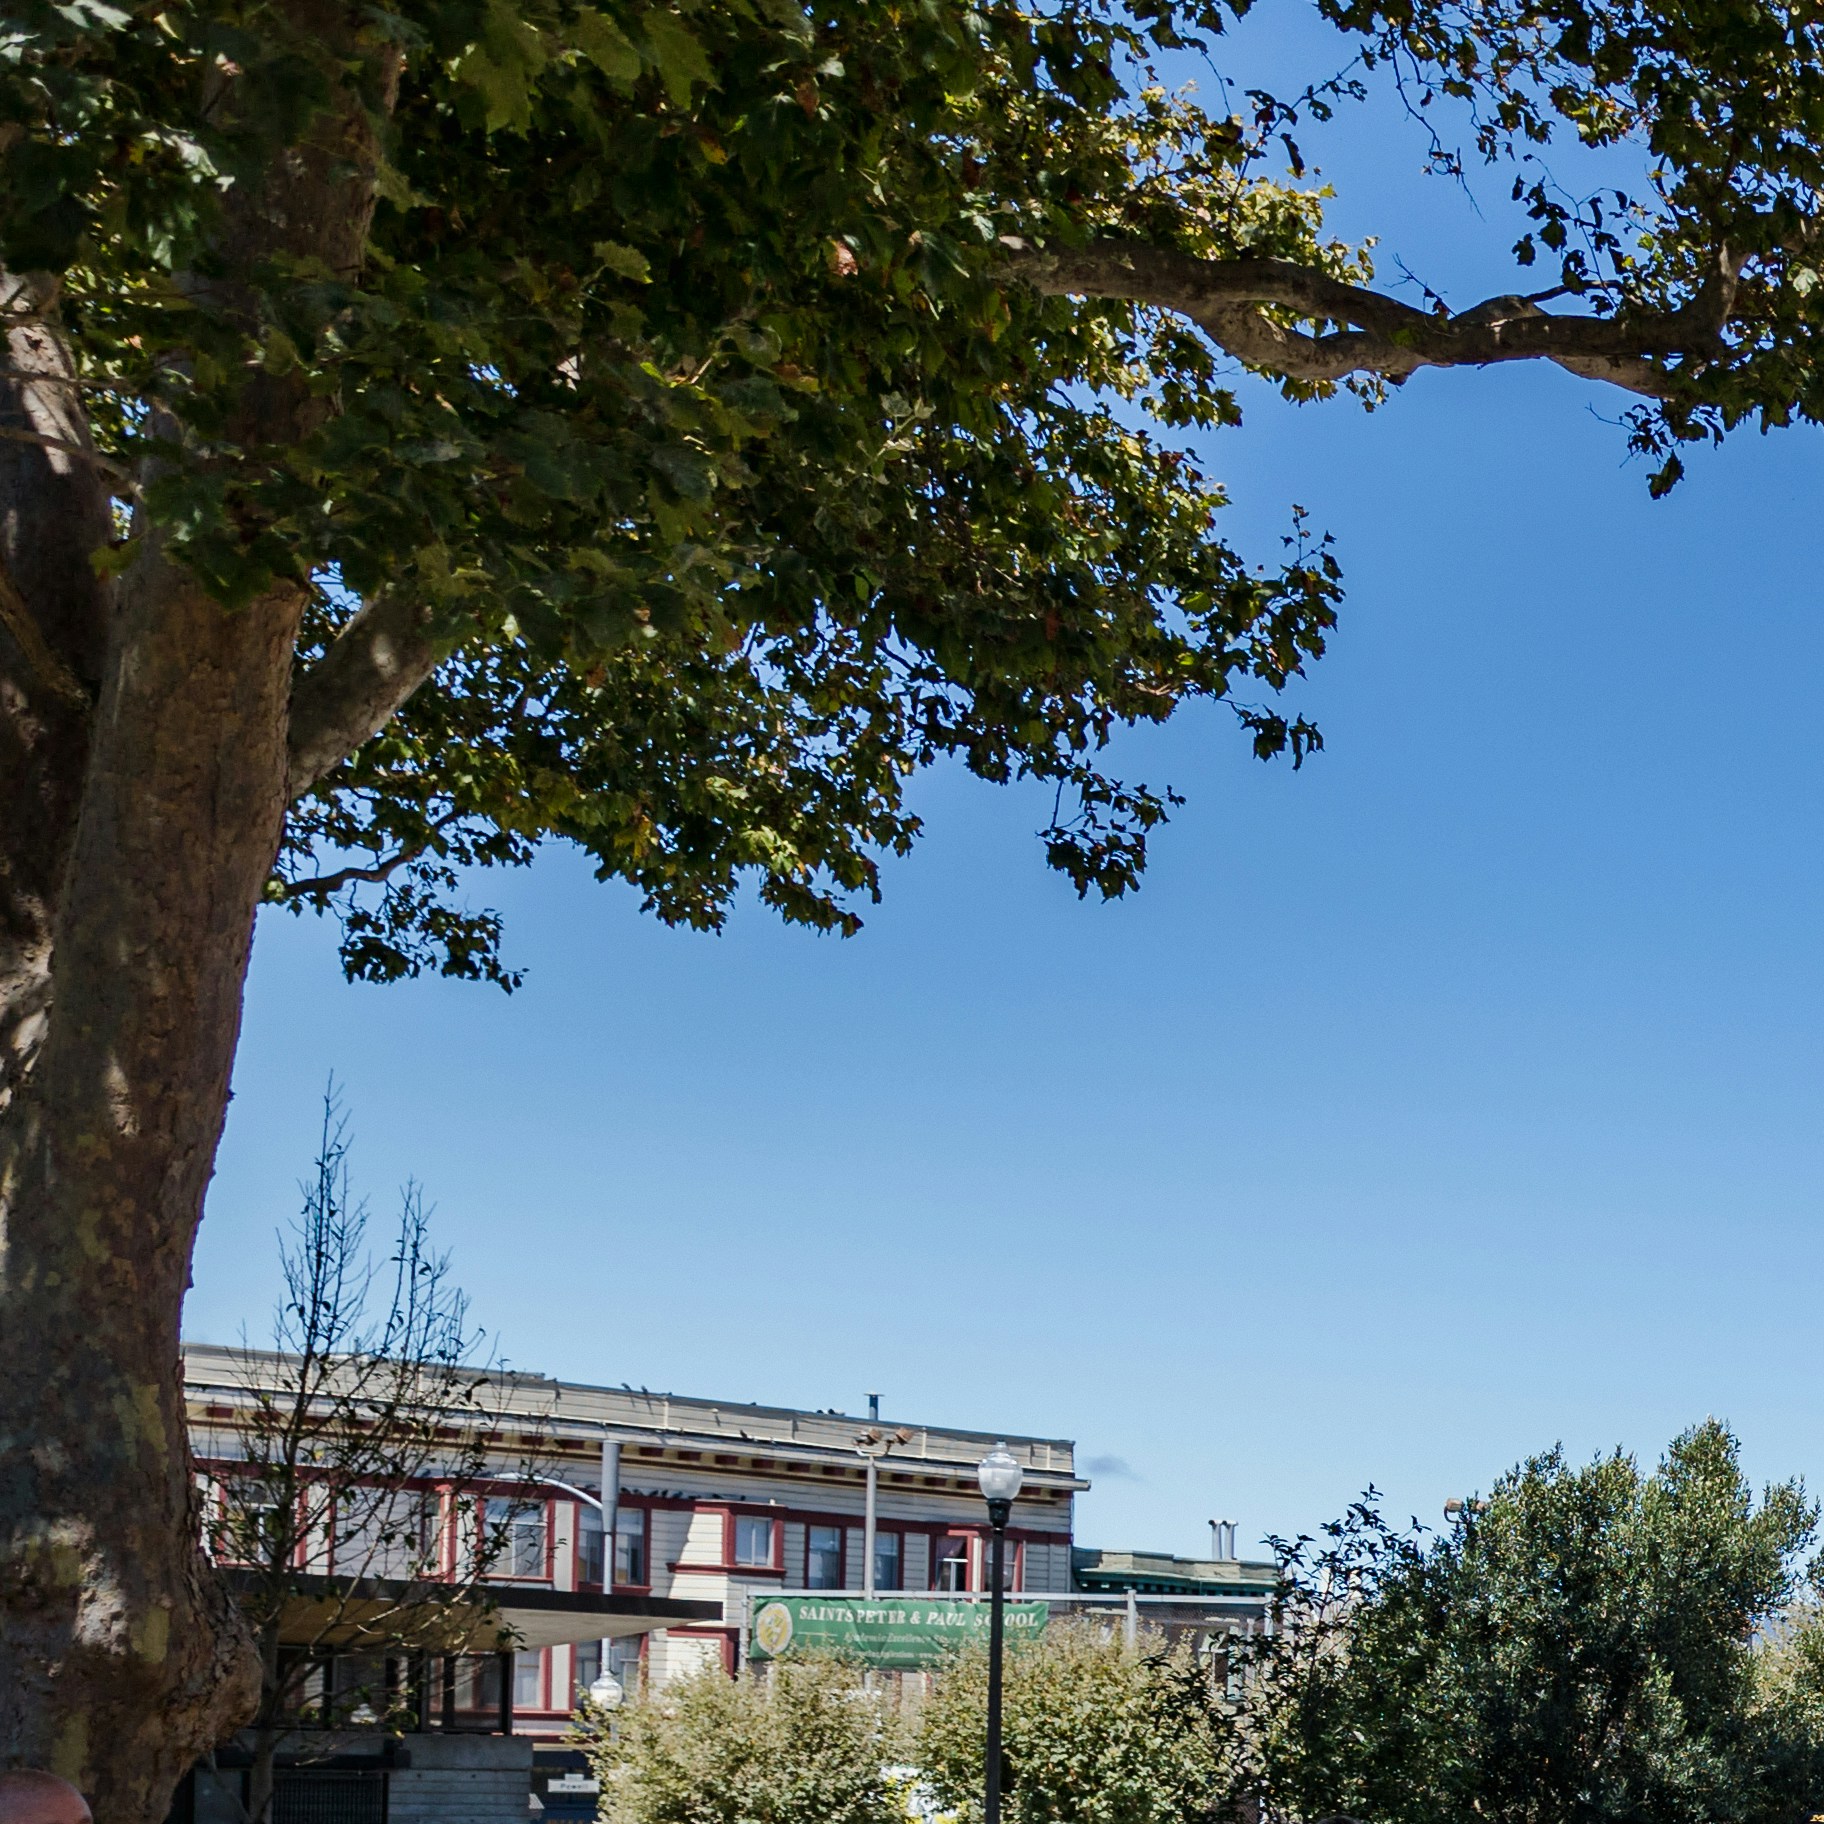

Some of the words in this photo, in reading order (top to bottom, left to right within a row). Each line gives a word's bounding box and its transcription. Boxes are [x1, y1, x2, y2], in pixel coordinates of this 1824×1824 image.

[799, 1606, 852, 1622] SAINTS
[856, 1610, 906, 1624] PETER
[910, 1611, 920, 1624] &
[926, 1612, 966, 1626] PAUL
[973, 1614, 1038, 1627] SCOOL
